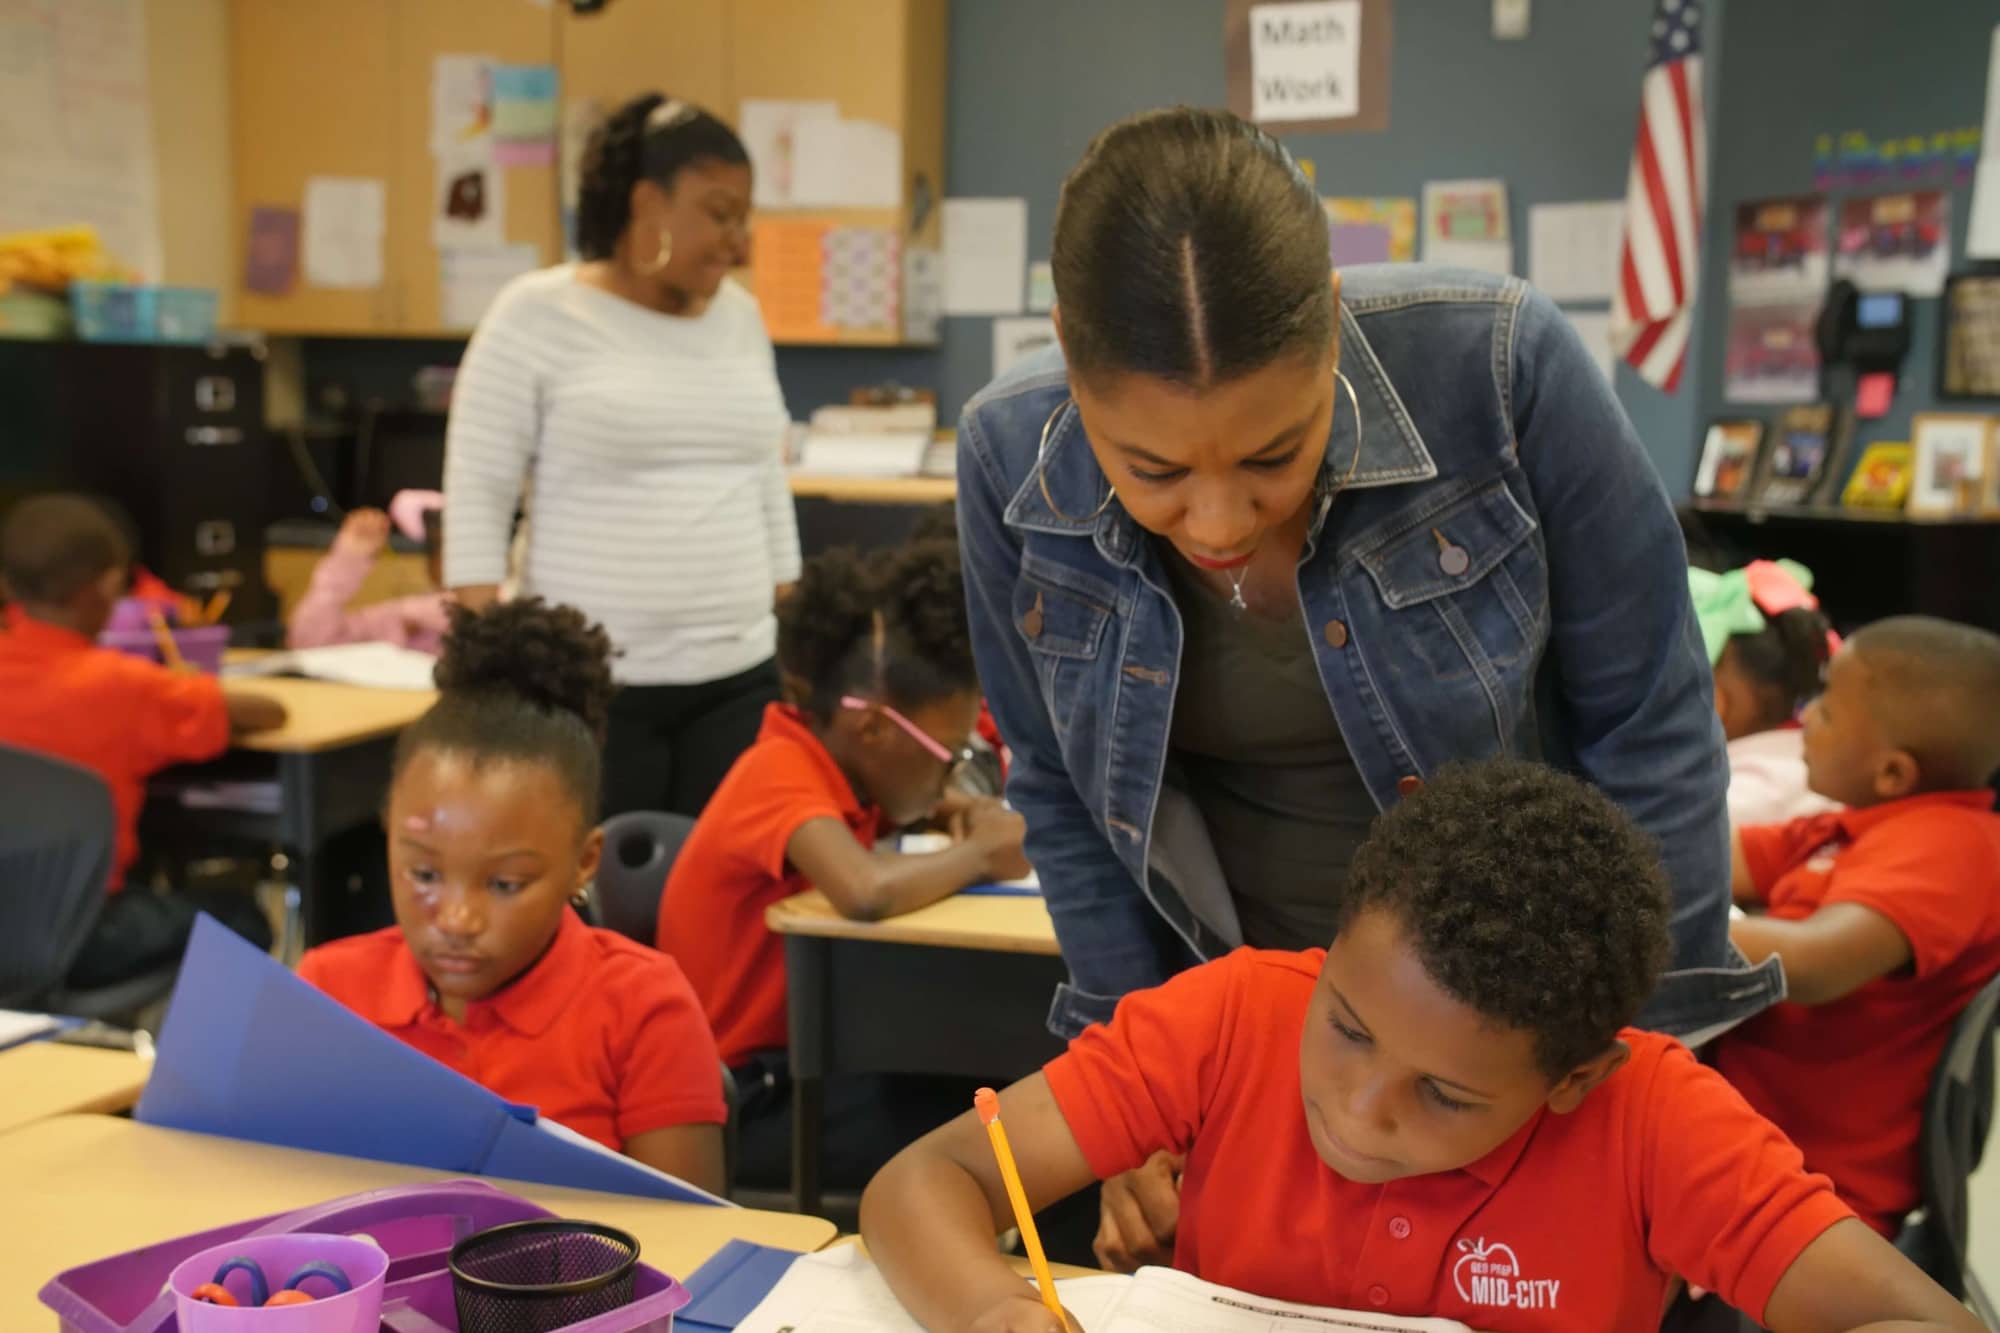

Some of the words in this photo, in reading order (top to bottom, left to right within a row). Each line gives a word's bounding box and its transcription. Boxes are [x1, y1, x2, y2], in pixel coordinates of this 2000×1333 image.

[1261, 16, 1344, 45] Math
[1260, 71, 1342, 101] Work
[1471, 1276, 1560, 1309] MID-CITY
